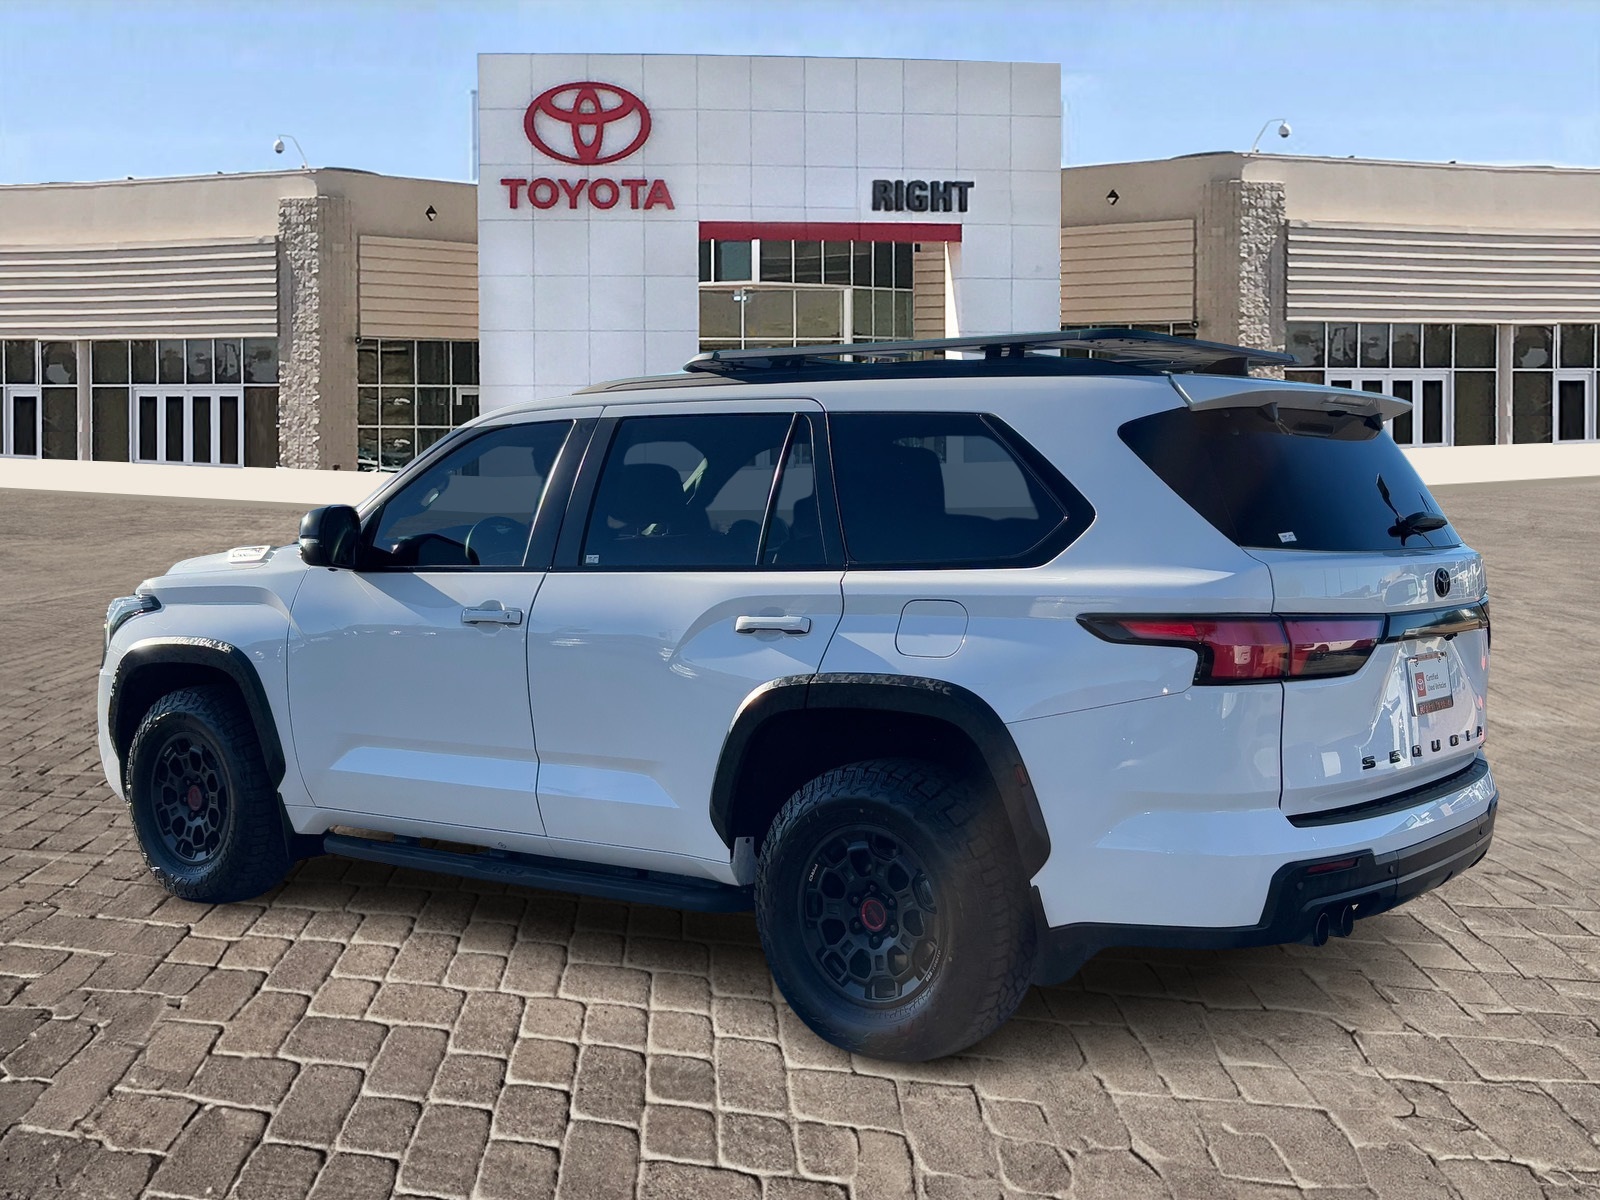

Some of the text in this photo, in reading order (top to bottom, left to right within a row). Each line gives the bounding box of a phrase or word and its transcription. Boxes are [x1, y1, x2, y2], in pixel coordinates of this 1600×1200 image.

[501, 178, 675, 210] TOYOTA
[872, 180, 975, 213] RIGHT
[1362, 726, 1483, 770] SEQUOIA
